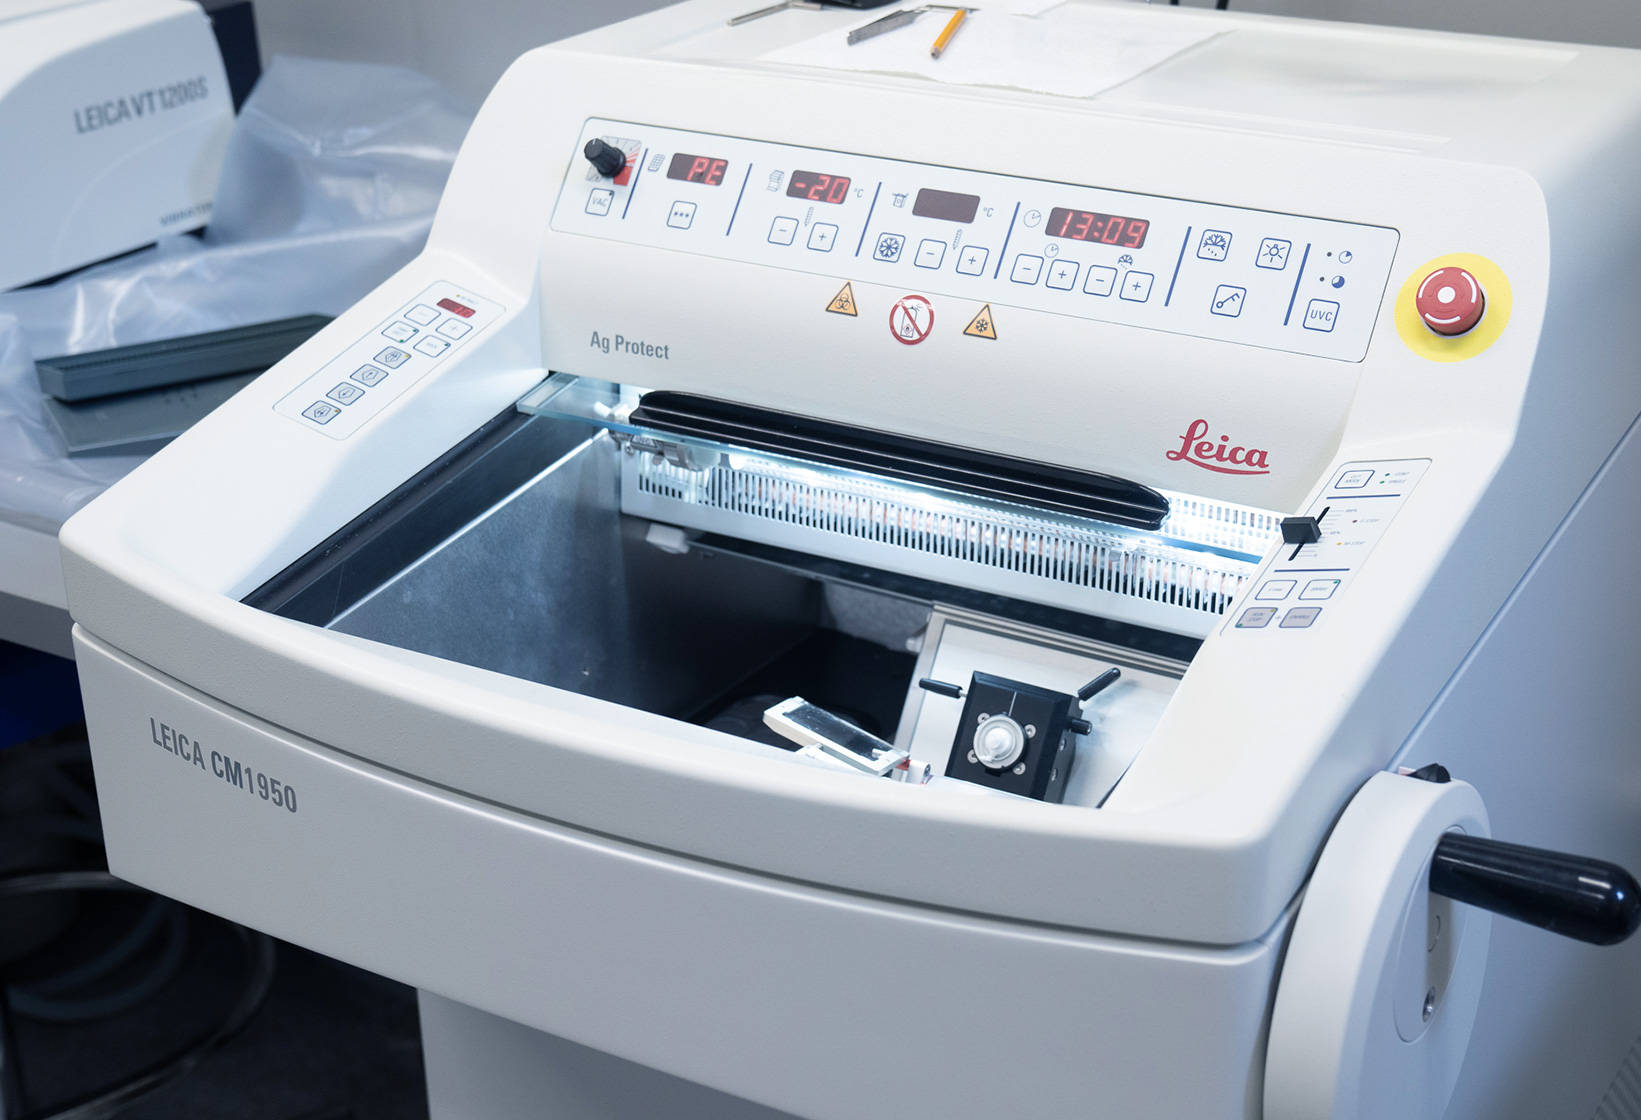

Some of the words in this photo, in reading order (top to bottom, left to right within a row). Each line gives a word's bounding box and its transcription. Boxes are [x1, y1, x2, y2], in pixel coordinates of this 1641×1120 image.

[74, 98, 131, 134] LEICA
[686, 157, 726, 186] PE
[591, 196, 609, 207] VAC
[794, 175, 849, 204] -20
[1058, 211, 1147, 248] 13:09
[1310, 309, 1333, 322] UVC
[590, 331, 610, 353] Ag
[615, 334, 669, 360] Protect
[1166, 418, 1270, 475] Leica
[150, 717, 206, 770] LEICA
[211, 750, 297, 814] CM1950
